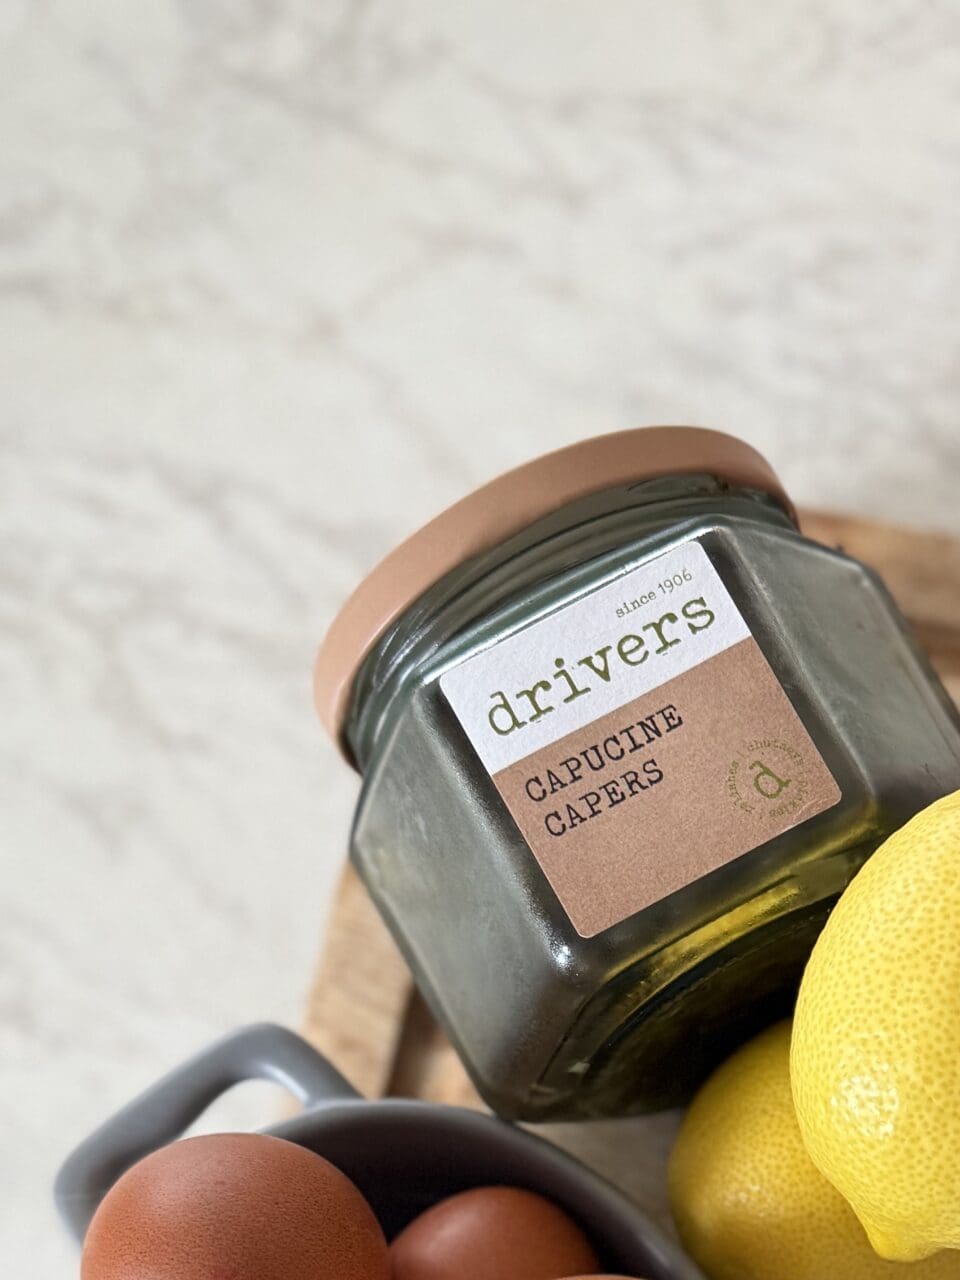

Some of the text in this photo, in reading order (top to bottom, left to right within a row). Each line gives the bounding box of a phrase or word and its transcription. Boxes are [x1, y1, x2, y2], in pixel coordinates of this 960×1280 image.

[615, 568, 693, 618] since 1906
[488, 596, 716, 737] drivers
[525, 704, 684, 802] CAPUCINE
[749, 760, 792, 799] d
[544, 758, 665, 837] CAPERS
